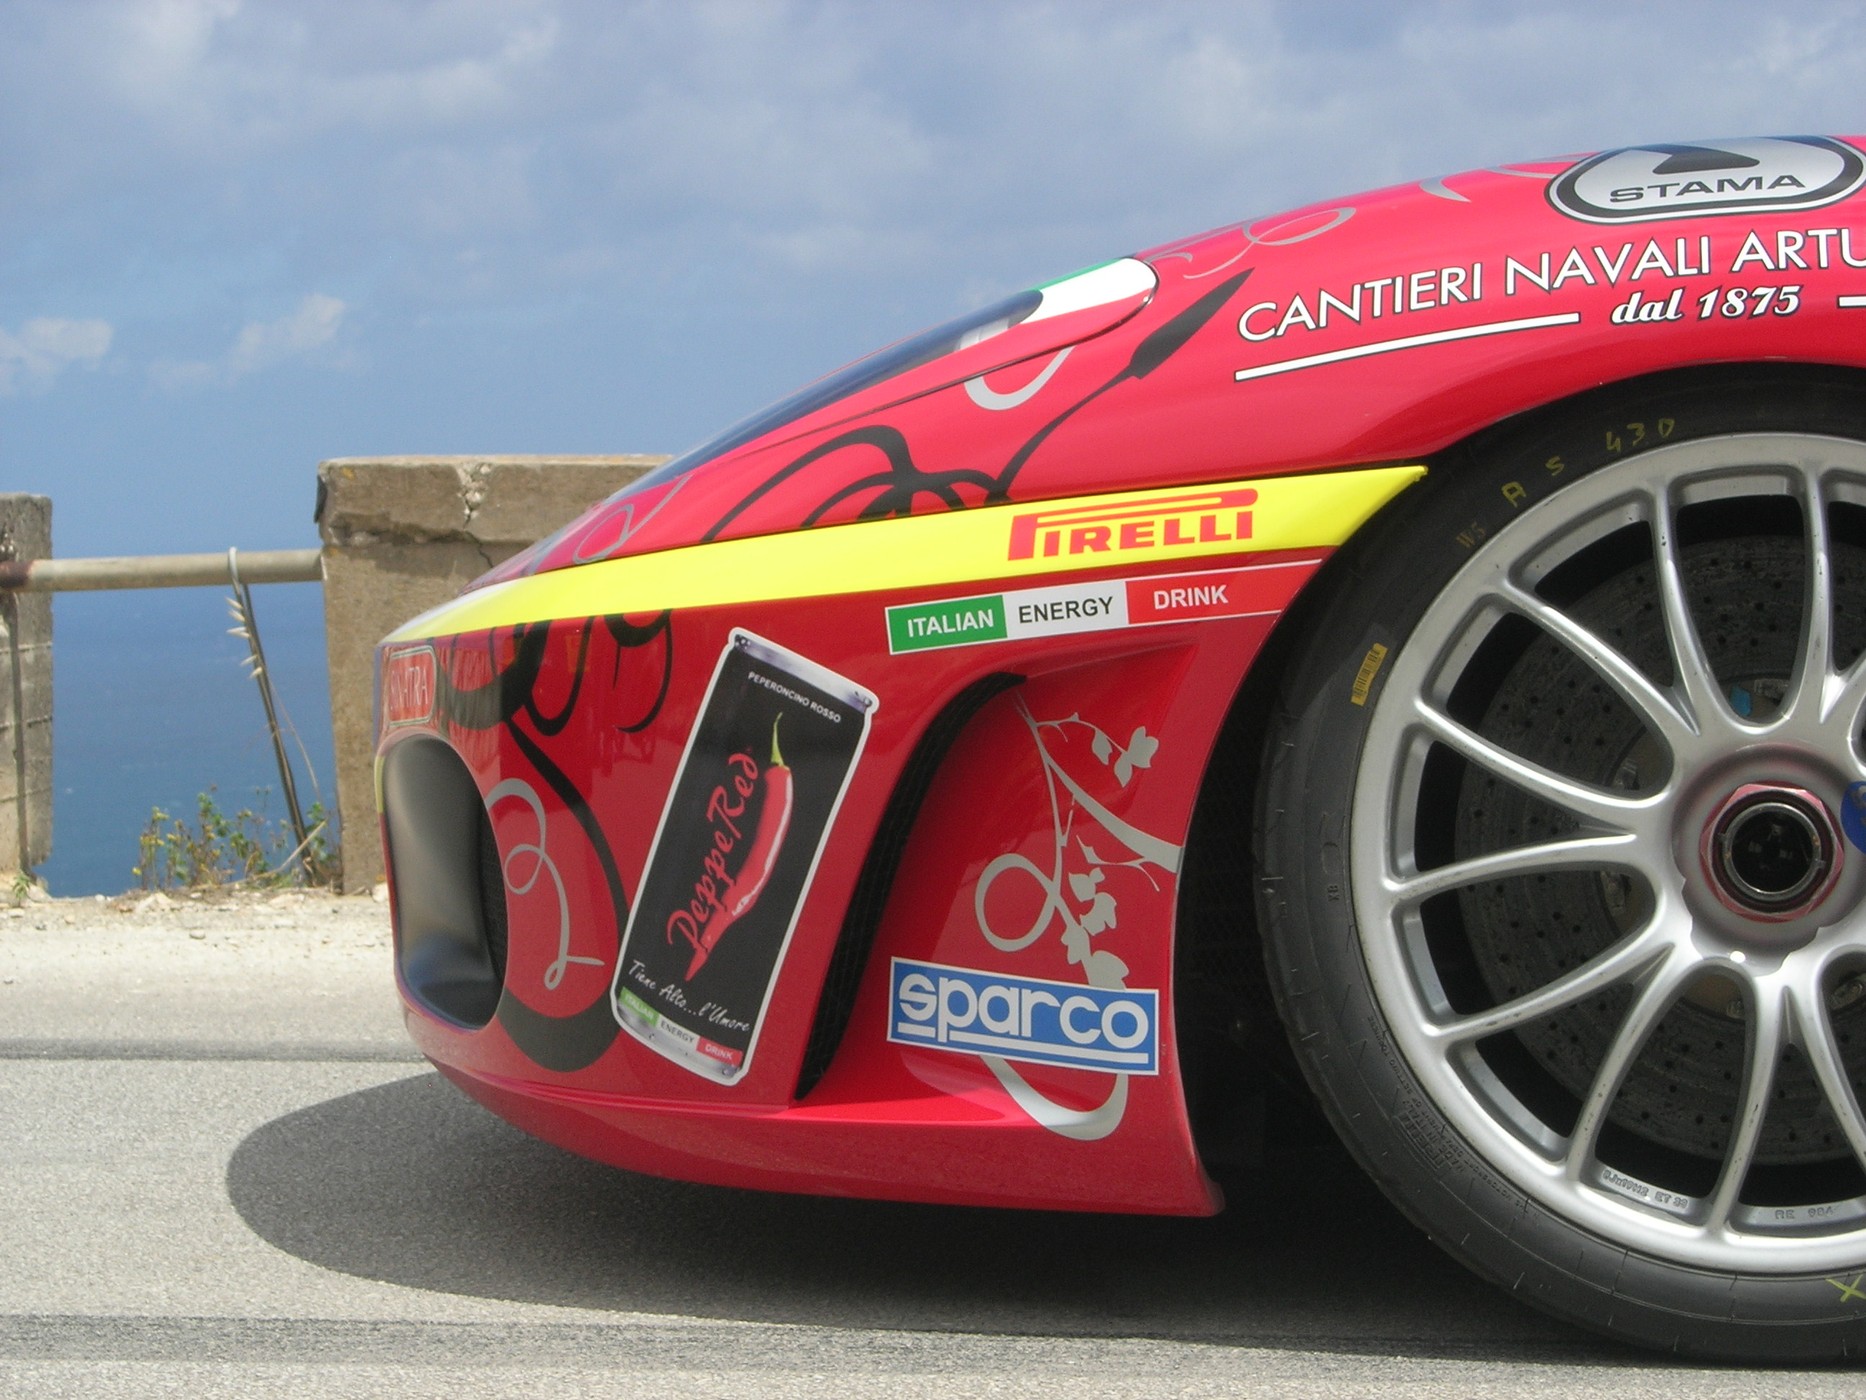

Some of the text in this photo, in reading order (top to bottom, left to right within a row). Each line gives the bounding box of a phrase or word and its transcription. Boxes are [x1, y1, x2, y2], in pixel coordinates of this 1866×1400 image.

[1609, 173, 1807, 203] STAMA
[1237, 263, 1483, 343] CANTIERI
[1505, 234, 1711, 296] NAVALI
[1610, 284, 1803, 325] dal 1875
[1007, 487, 1259, 562] PIRELLI
[907, 584, 1229, 638] ITALIAN ENERGY DRINK
[747, 670, 842, 724] PEPERONCINO ROSSO
[898, 972, 1150, 1050] sparco
[660, 1019, 695, 1044] ENERGY
[704, 1042, 734, 1060] DRINK
